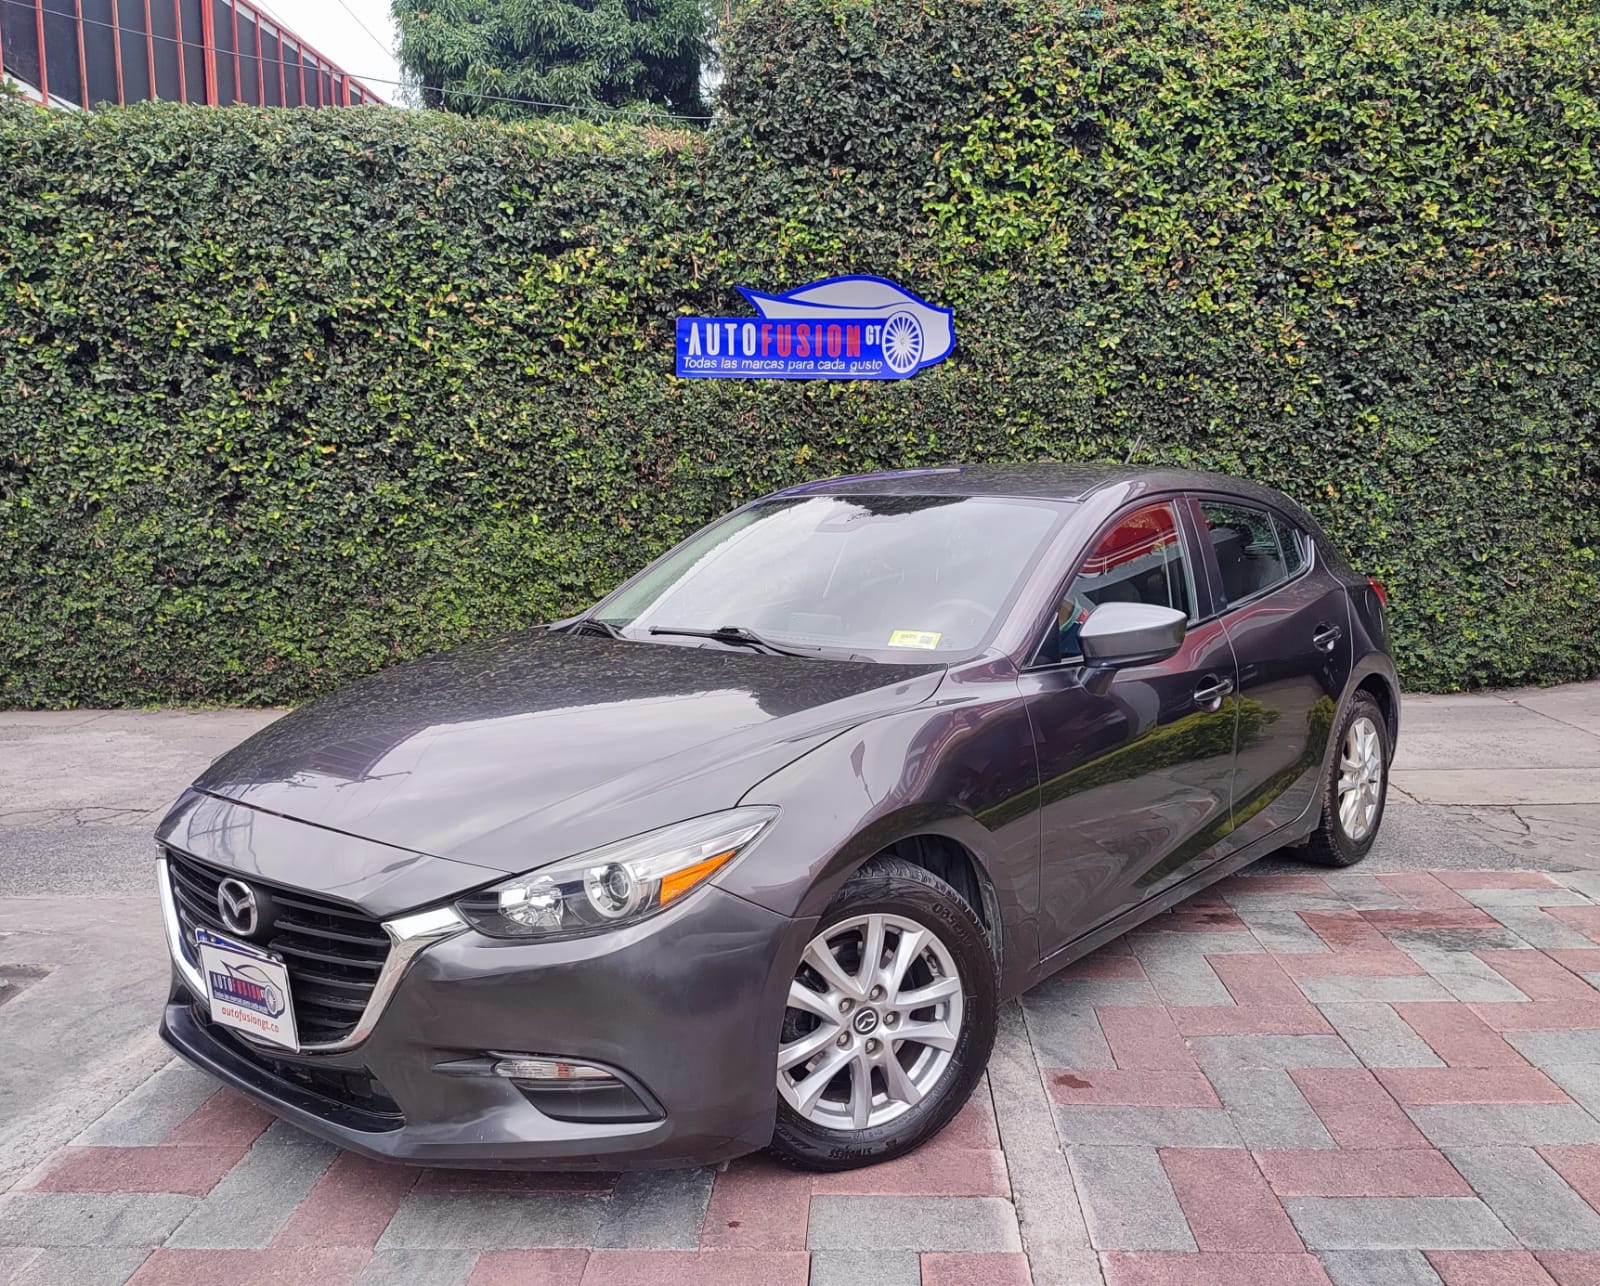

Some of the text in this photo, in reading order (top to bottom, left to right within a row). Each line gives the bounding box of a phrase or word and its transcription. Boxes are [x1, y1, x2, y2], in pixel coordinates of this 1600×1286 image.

[865, 325, 881, 345] GT
[684, 356, 883, 373] Todas las marcas para cada gusto
[221, 1006, 280, 1033] autofusiongt.co
